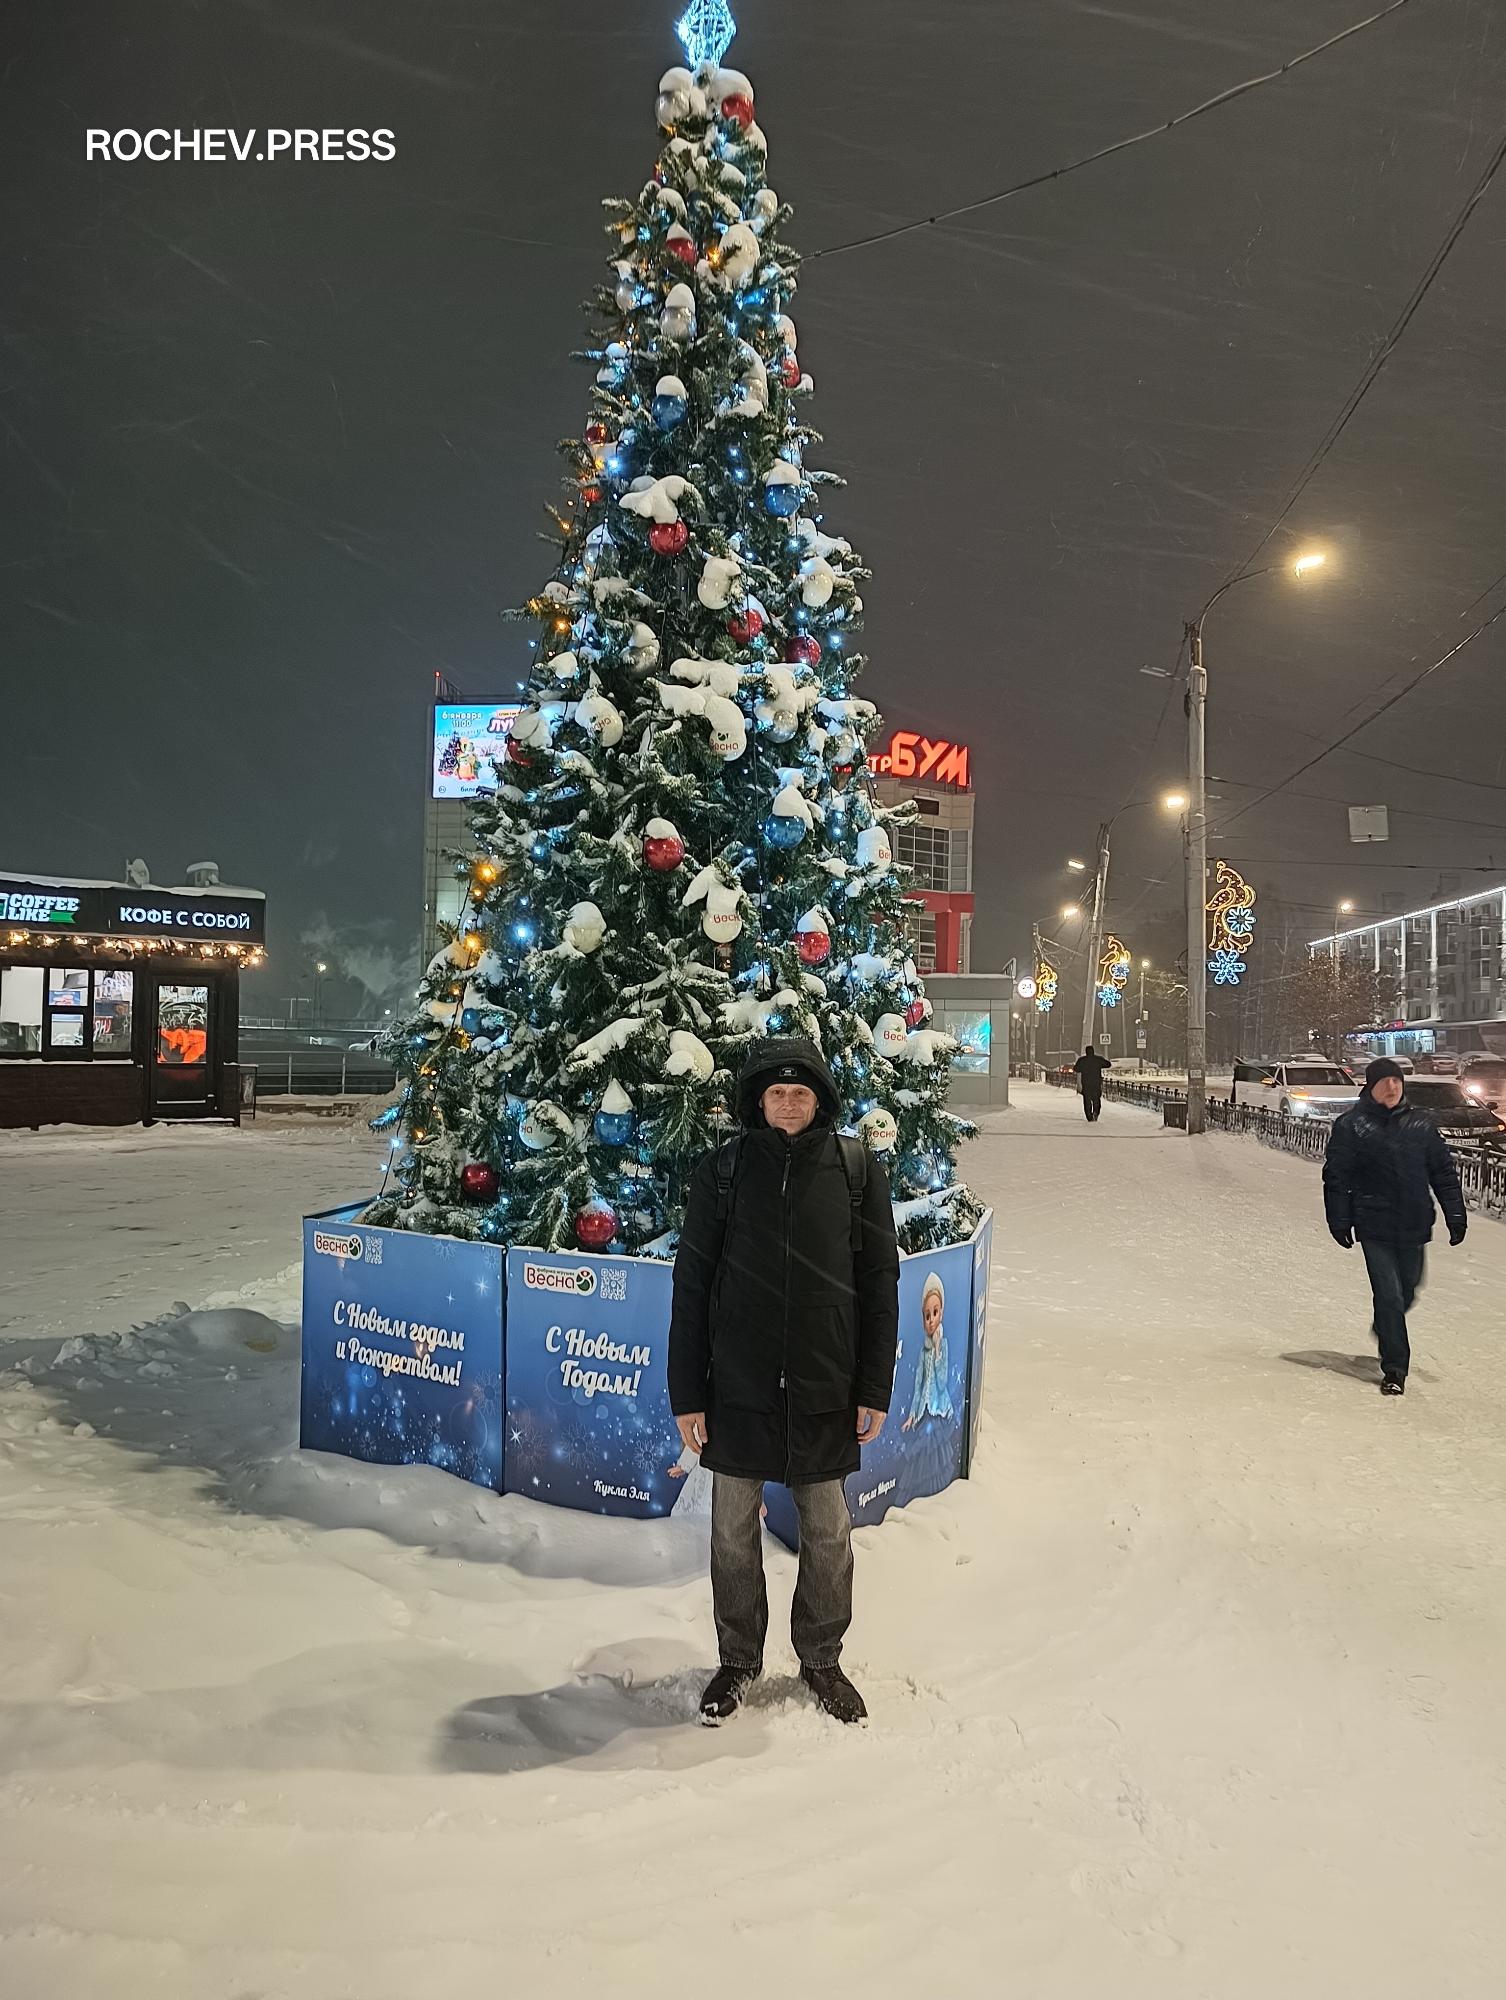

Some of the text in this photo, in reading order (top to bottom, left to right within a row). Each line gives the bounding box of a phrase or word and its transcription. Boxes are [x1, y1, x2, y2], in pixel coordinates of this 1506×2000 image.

[450, 712, 482, 721] января
[891, 732, 968, 787] БУМ
[9, 893, 80, 911] COFFEE
[8, 906, 50, 922] LIKE
[120, 906, 250, 930] КОФЕ С СОБОЙ
[316, 1235, 349, 1254] Весна
[527, 1267, 575, 1289] Весна
[333, 1300, 465, 1353] С Новым годом
[545, 1325, 651, 1367] С Новым
[335, 1337, 463, 1387] и Рождеством!
[560, 1359, 642, 1398] Годом!
[593, 1479, 650, 1502] Кукла Эля
